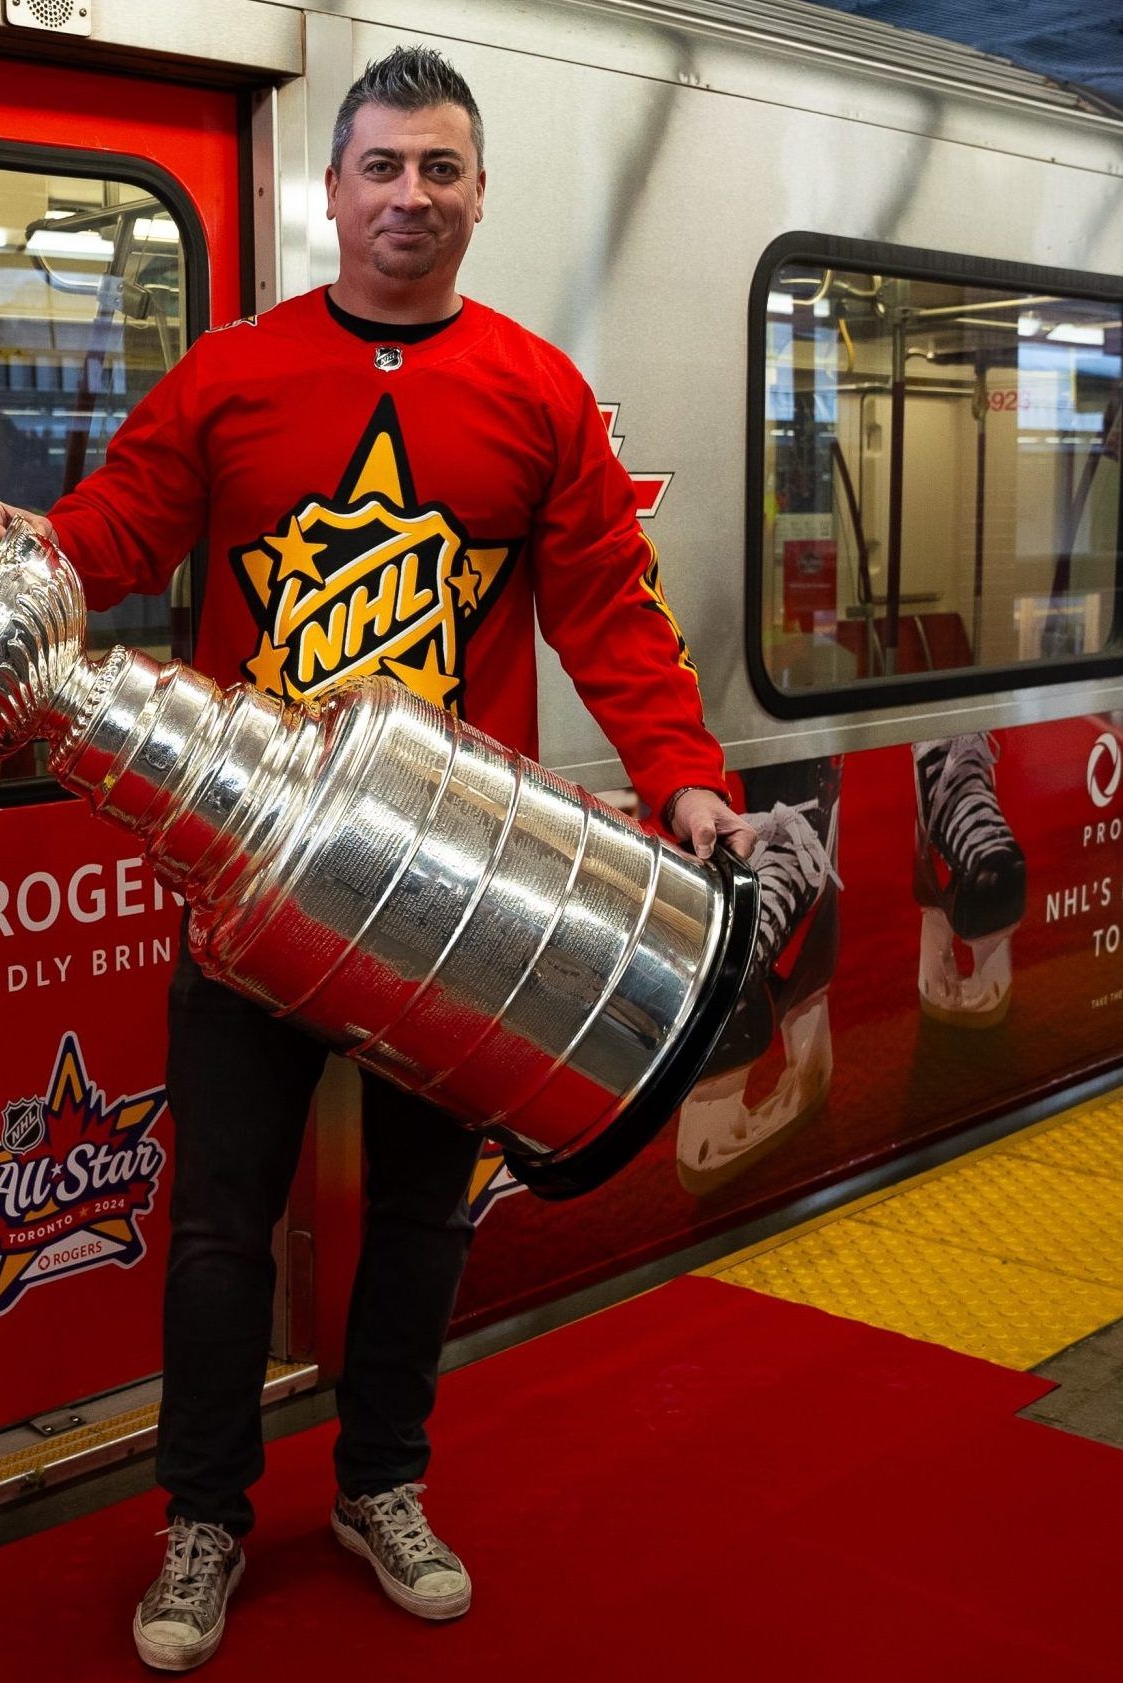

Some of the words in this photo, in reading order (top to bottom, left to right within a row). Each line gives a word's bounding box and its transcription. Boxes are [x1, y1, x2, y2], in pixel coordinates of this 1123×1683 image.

[297, 552, 434, 683] NHL
[1083, 817, 1122, 847] PRO
[1045, 877, 1112, 923] NHL'S
[92, 936, 171, 976] BRIN
[1093, 924, 1120, 957] TO
[11, 1111, 36, 1145] NHL
[56, 1141, 159, 1202] Star
[8, 1214, 74, 1244] TORONTO
[94, 1198, 126, 1214] 2024
[53, 1241, 103, 1266] ROGERS
